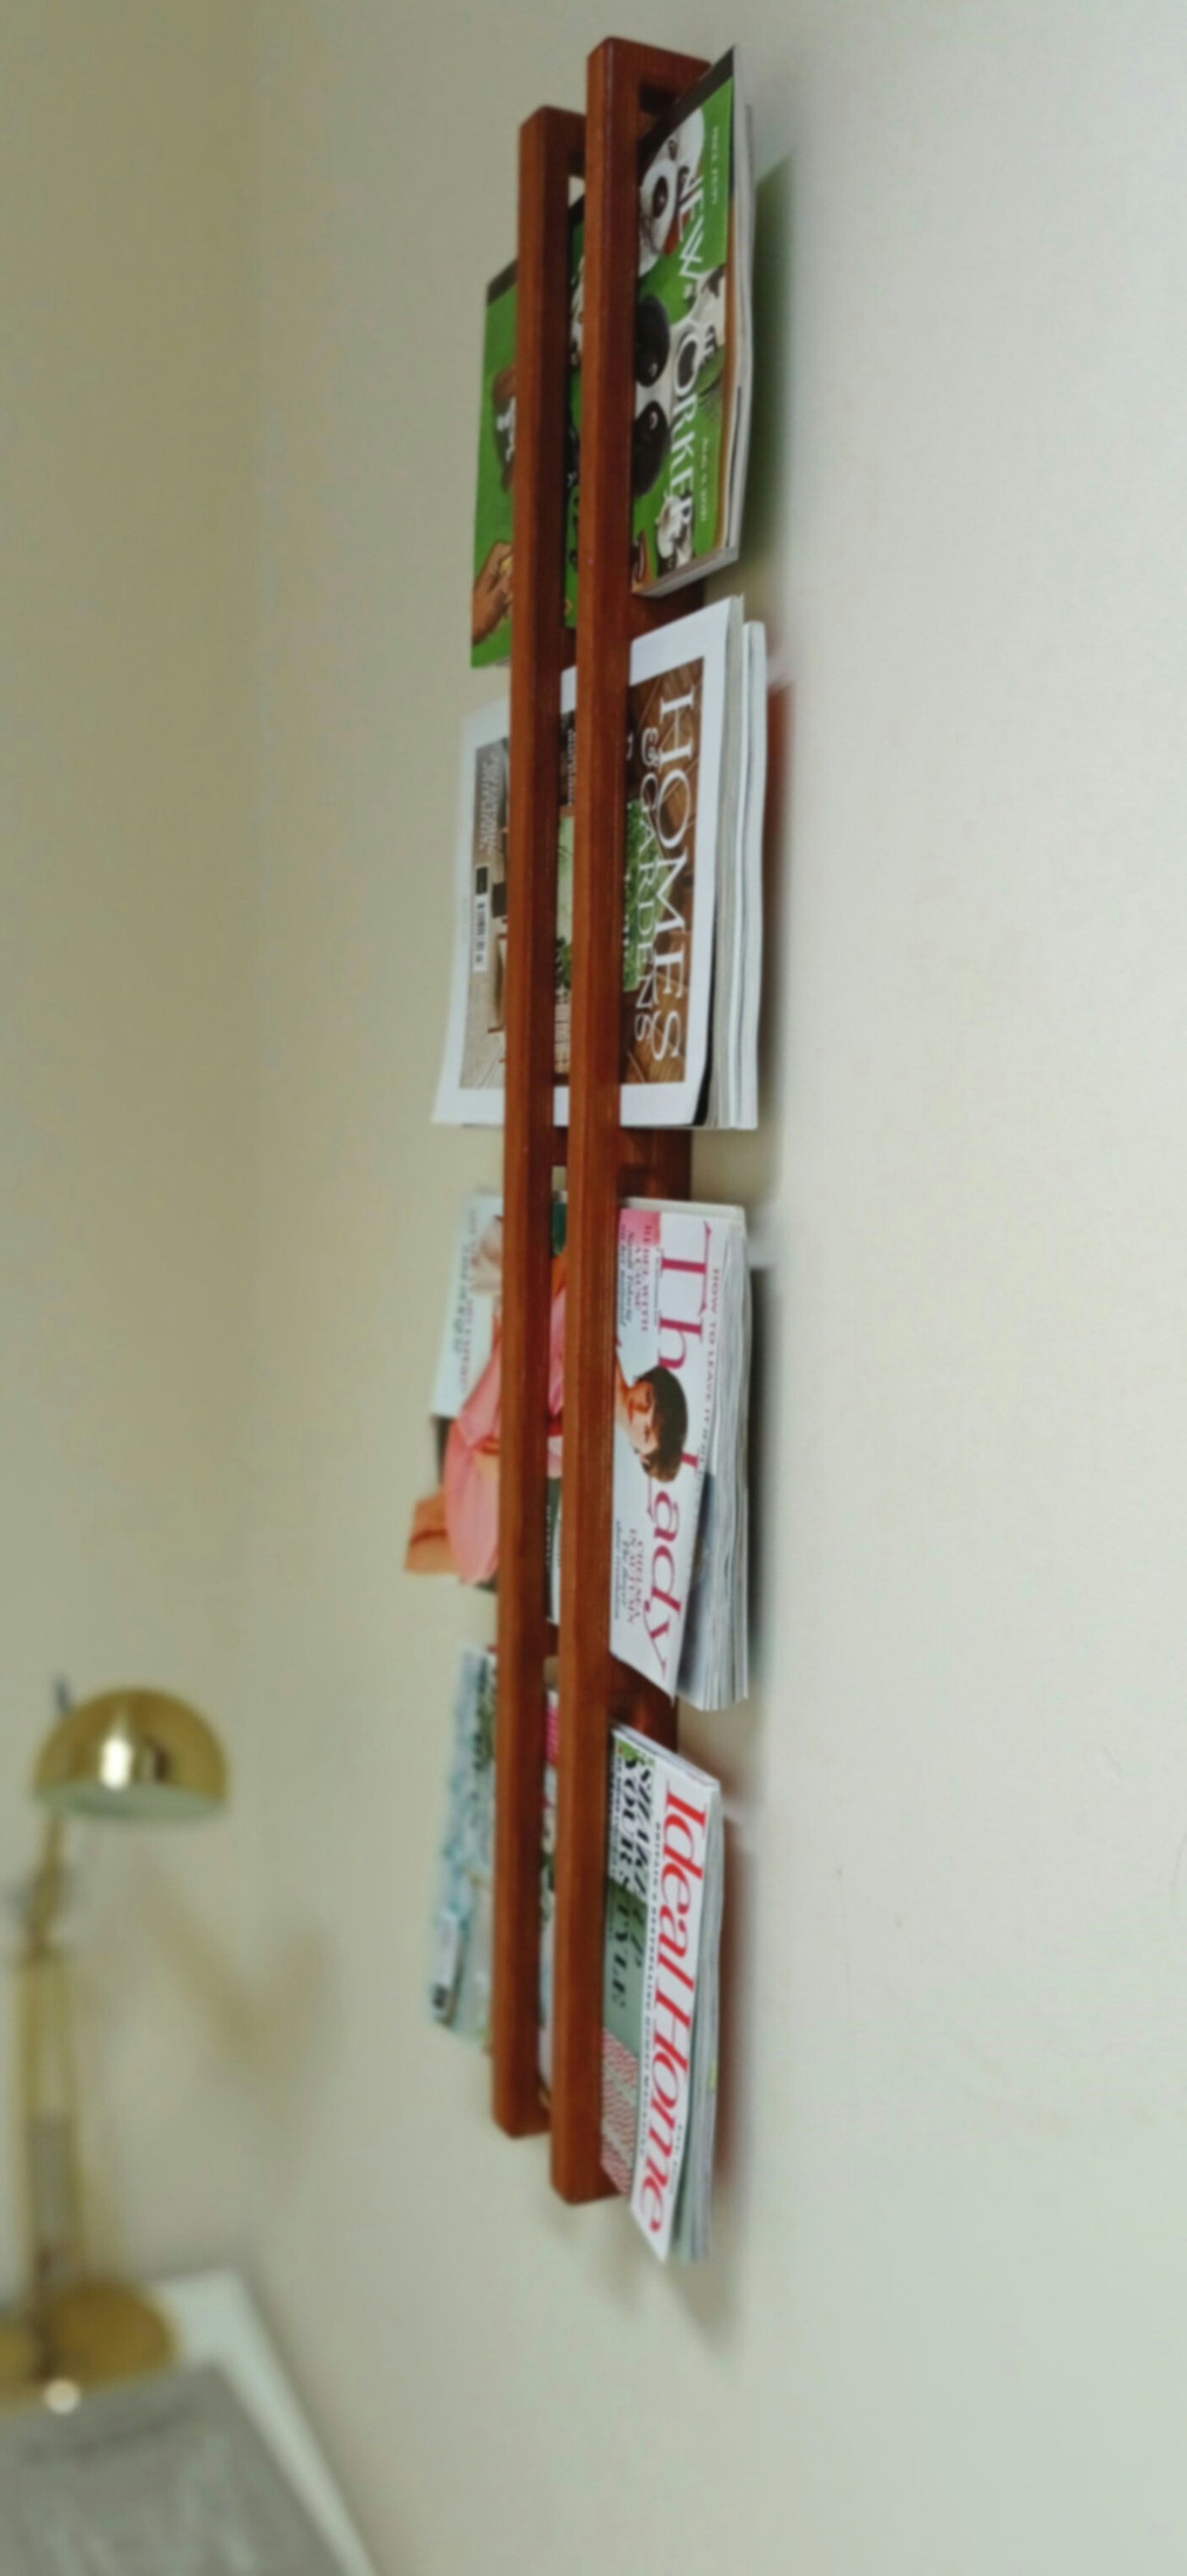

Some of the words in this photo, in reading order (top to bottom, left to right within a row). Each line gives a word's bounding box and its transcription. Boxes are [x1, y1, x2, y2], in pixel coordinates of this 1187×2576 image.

[640, 726, 661, 768] &
[634, 772, 659, 1043] GARDENS
[650, 685, 696, 1060] HOMES
[641, 1284, 650, 1332] WITH
[657, 1220, 712, 1374] Th
[709, 1321, 717, 1344] TO
[711, 1267, 720, 1314] HOW
[706, 1350, 715, 1402] LEAVE
[642, 1448, 700, 1680] Lady
[618, 1756, 638, 1868] YOUR
[652, 1821, 661, 1902] BRITAIN'S
[656, 1780, 708, 1992] Ideal
[646, 1906, 657, 2010] BESTSELLING
[639, 1977, 693, 2233] Home
